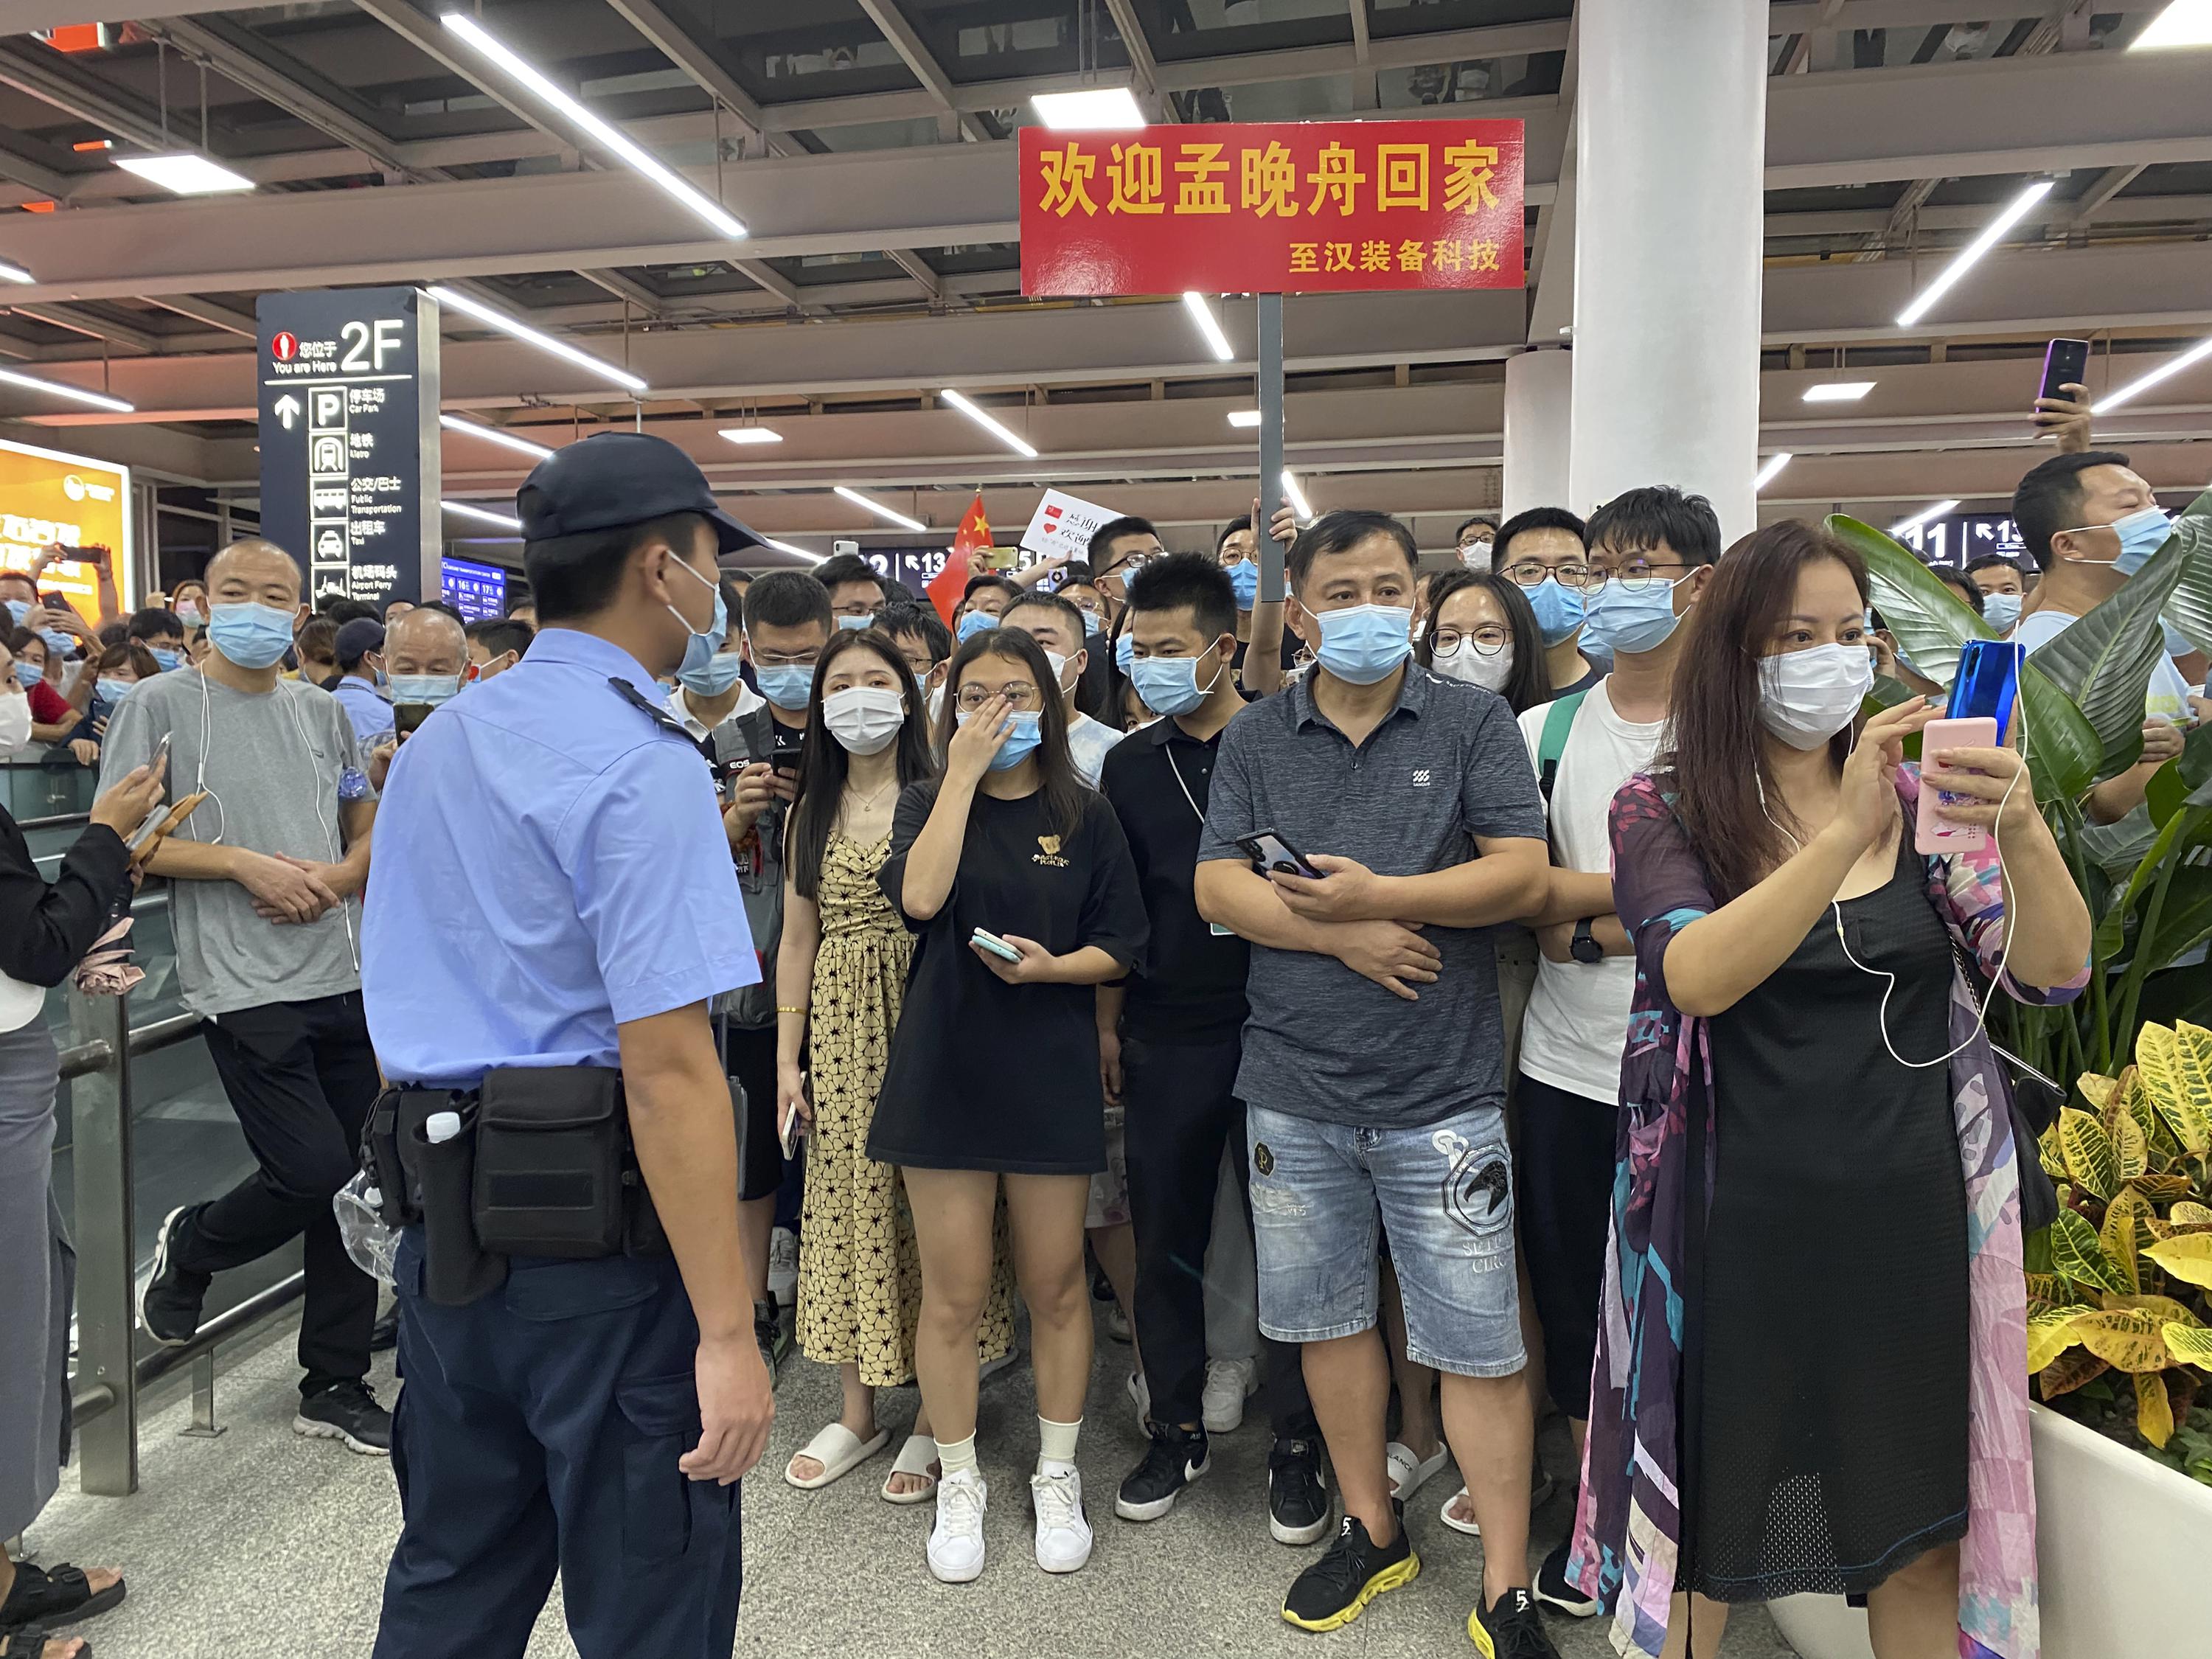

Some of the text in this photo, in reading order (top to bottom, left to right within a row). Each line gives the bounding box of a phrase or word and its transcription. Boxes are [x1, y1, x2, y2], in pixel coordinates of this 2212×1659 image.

[1038, 139, 1501, 218] 欢迎孟晚舟回家
[1289, 239, 1500, 274] 至汉装备科技
[299, 341, 337, 358] 您位于
[341, 319, 403, 371] 2F
[272, 360, 337, 374] You are Here
[349, 388, 385, 404] 停车场
[349, 403, 379, 414] Car Park
[350, 433, 374, 448] 地铁
[349, 450, 369, 459] Metro
[351, 476, 401, 492] 公交/巴士
[351, 494, 373, 504] Public
[351, 504, 402, 515] Transportation
[350, 521, 386, 535] 出租车
[351, 536, 364, 545] Taxi
[1905, 522, 1947, 558] 11
[922, 552, 946, 573] 13
[352, 580, 392, 591] Airport Ferry
[352, 591, 380, 601] Terminal
[730, 759, 750, 769] EOS
